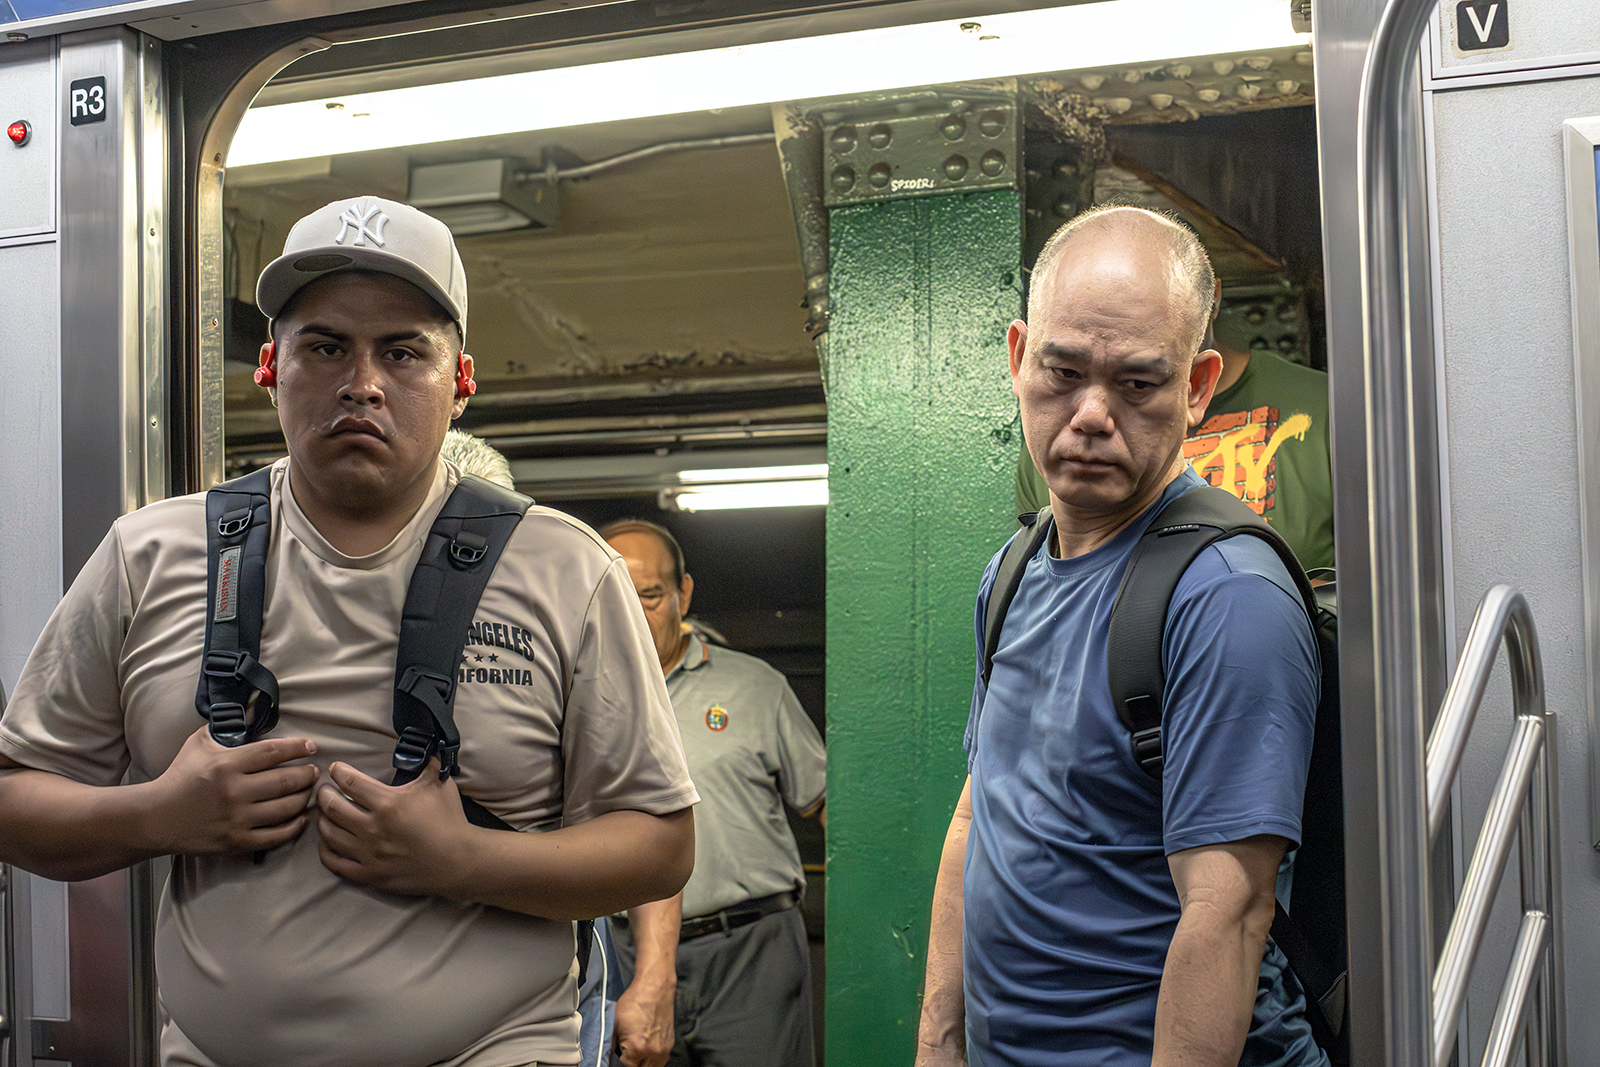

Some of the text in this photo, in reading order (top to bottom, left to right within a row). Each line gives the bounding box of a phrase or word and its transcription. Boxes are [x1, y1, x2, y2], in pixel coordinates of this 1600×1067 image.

[1465, 3, 1499, 43] V
[71, 85, 105, 118] R3
[335, 204, 390, 248] NY
